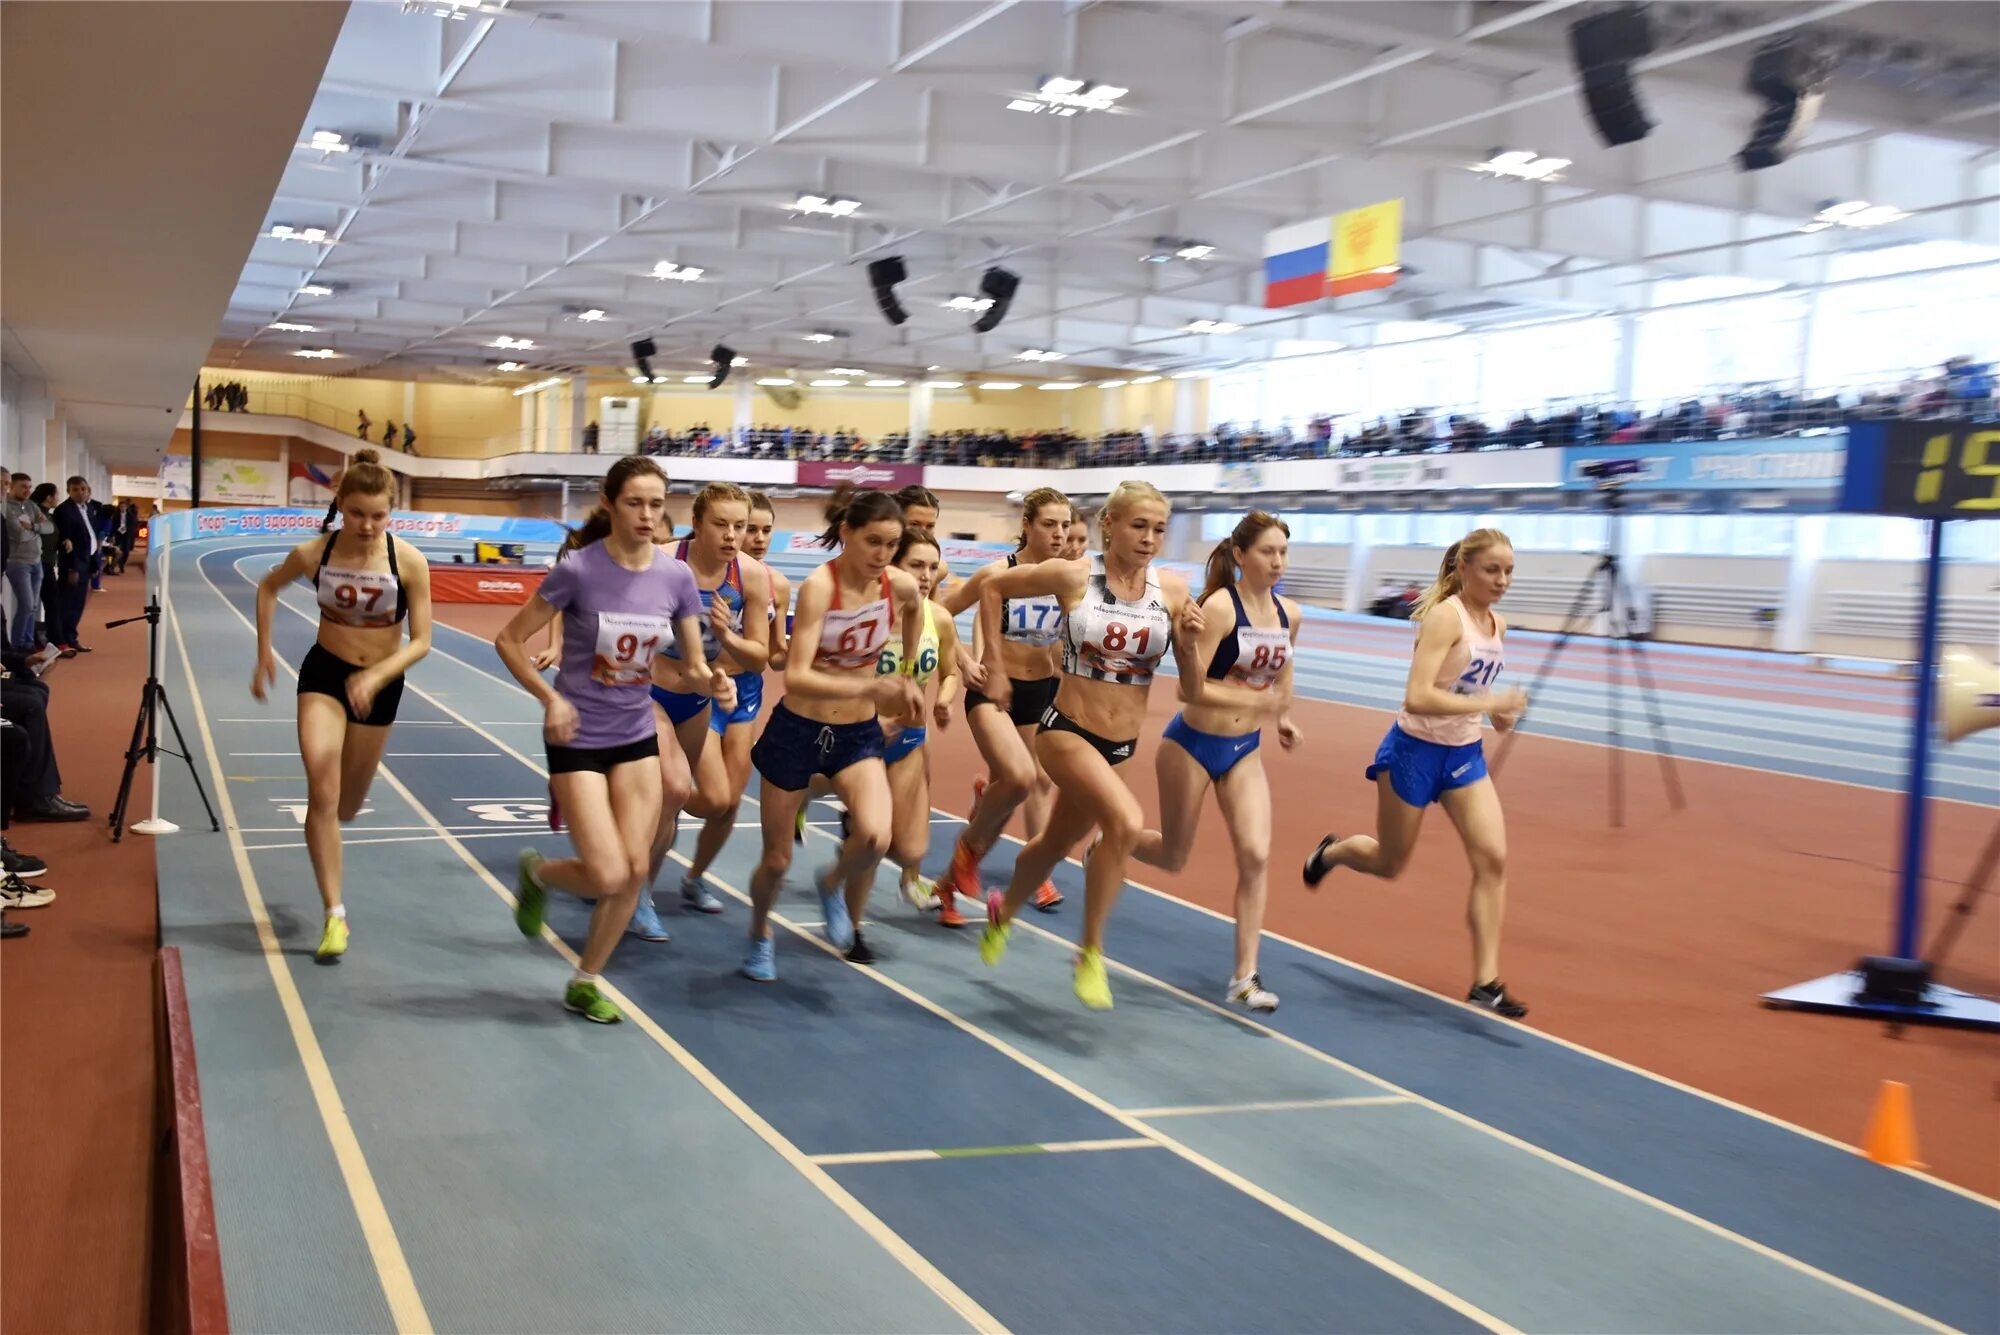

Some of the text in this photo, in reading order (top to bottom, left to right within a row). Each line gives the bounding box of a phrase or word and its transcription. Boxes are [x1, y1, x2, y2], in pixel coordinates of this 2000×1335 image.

[197, 514, 226, 531] Спорт
[241, 516, 261, 528] это
[335, 584, 384, 612] 97
[1012, 605, 1063, 629] 177
[616, 634, 659, 664] 91
[840, 619, 878, 652] 67
[1103, 622, 1150, 654] 81
[876, 648, 937, 675] 66
[1251, 645, 1286, 671] 85
